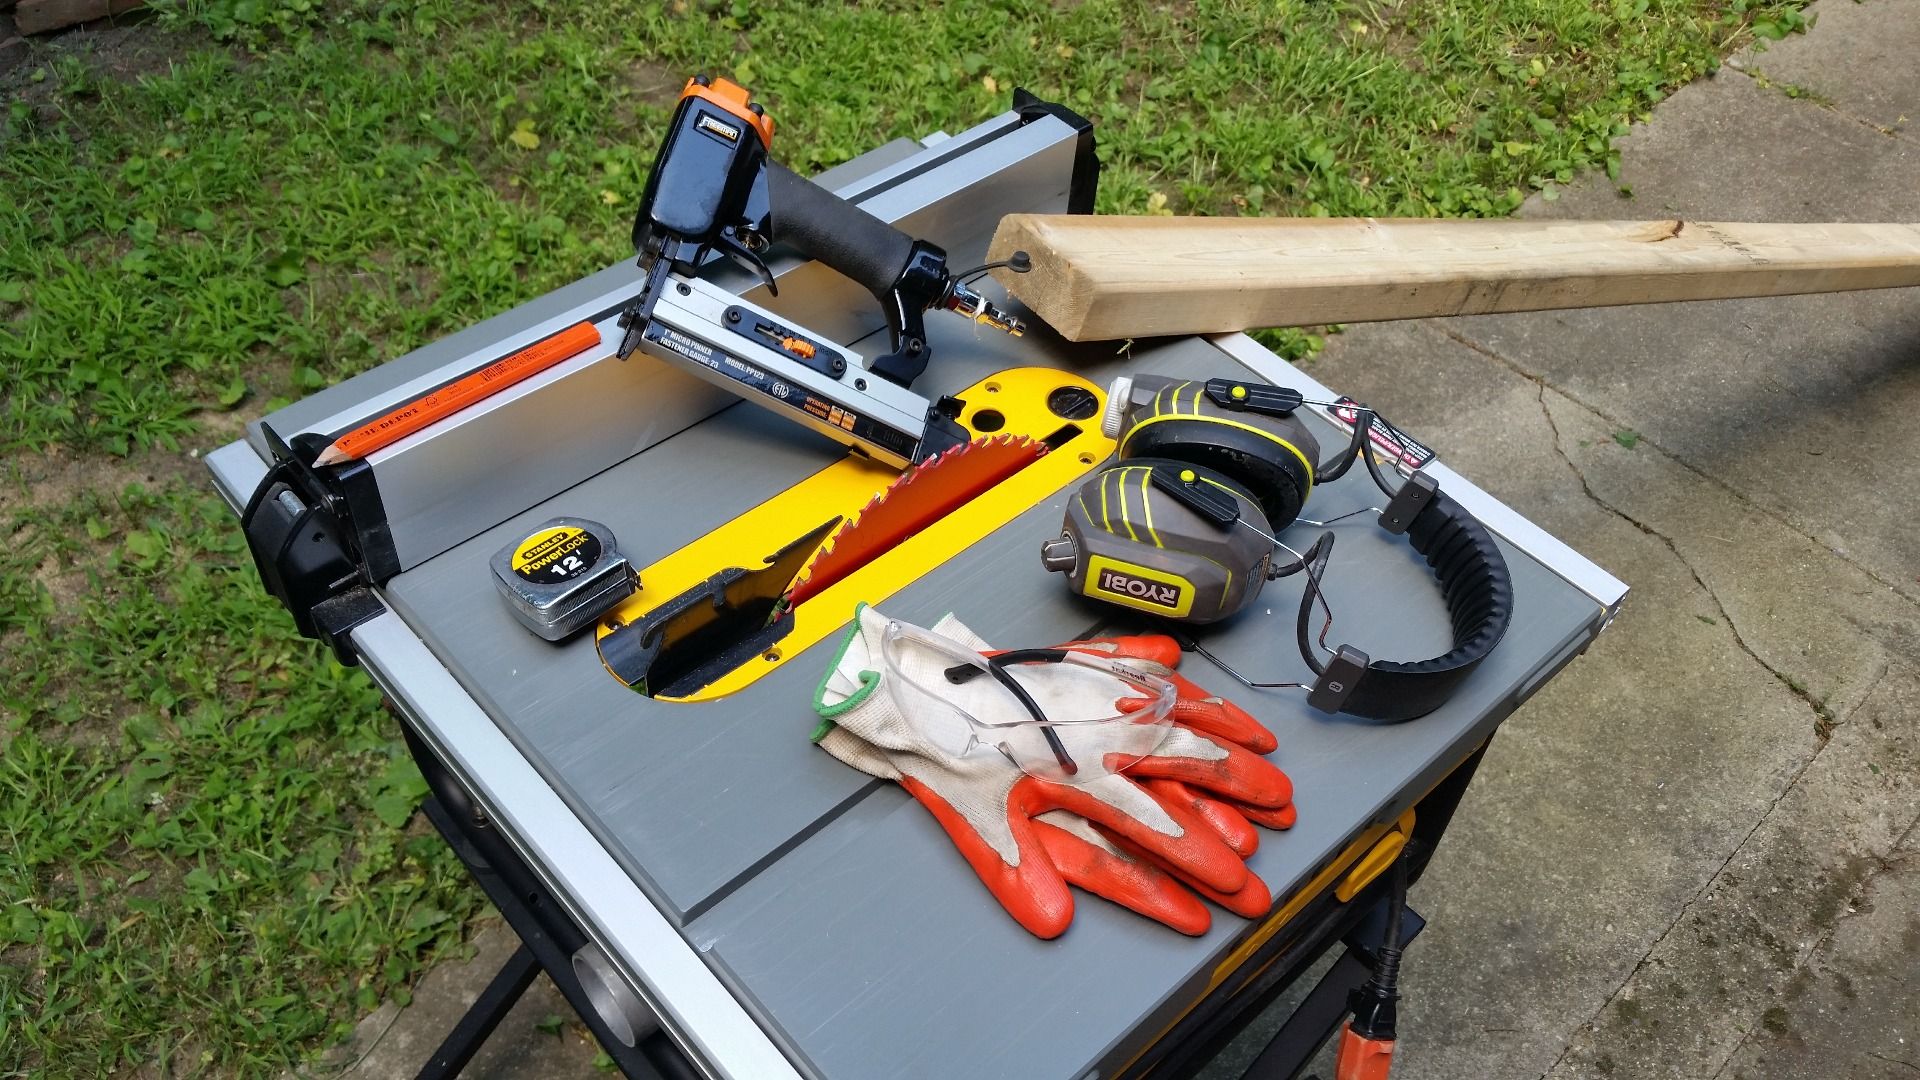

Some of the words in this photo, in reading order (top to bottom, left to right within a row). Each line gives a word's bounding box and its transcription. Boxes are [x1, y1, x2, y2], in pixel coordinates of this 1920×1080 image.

[660, 337, 689, 356] FASTENER
[670, 332, 691, 345] MICRO
[691, 340, 713, 355] PINNER
[521, 535, 588, 575] PowerLock
[525, 534, 563, 558] STANLEY
[551, 549, 583, 576] 12'
[1104, 573, 1176, 604] RYOBI
